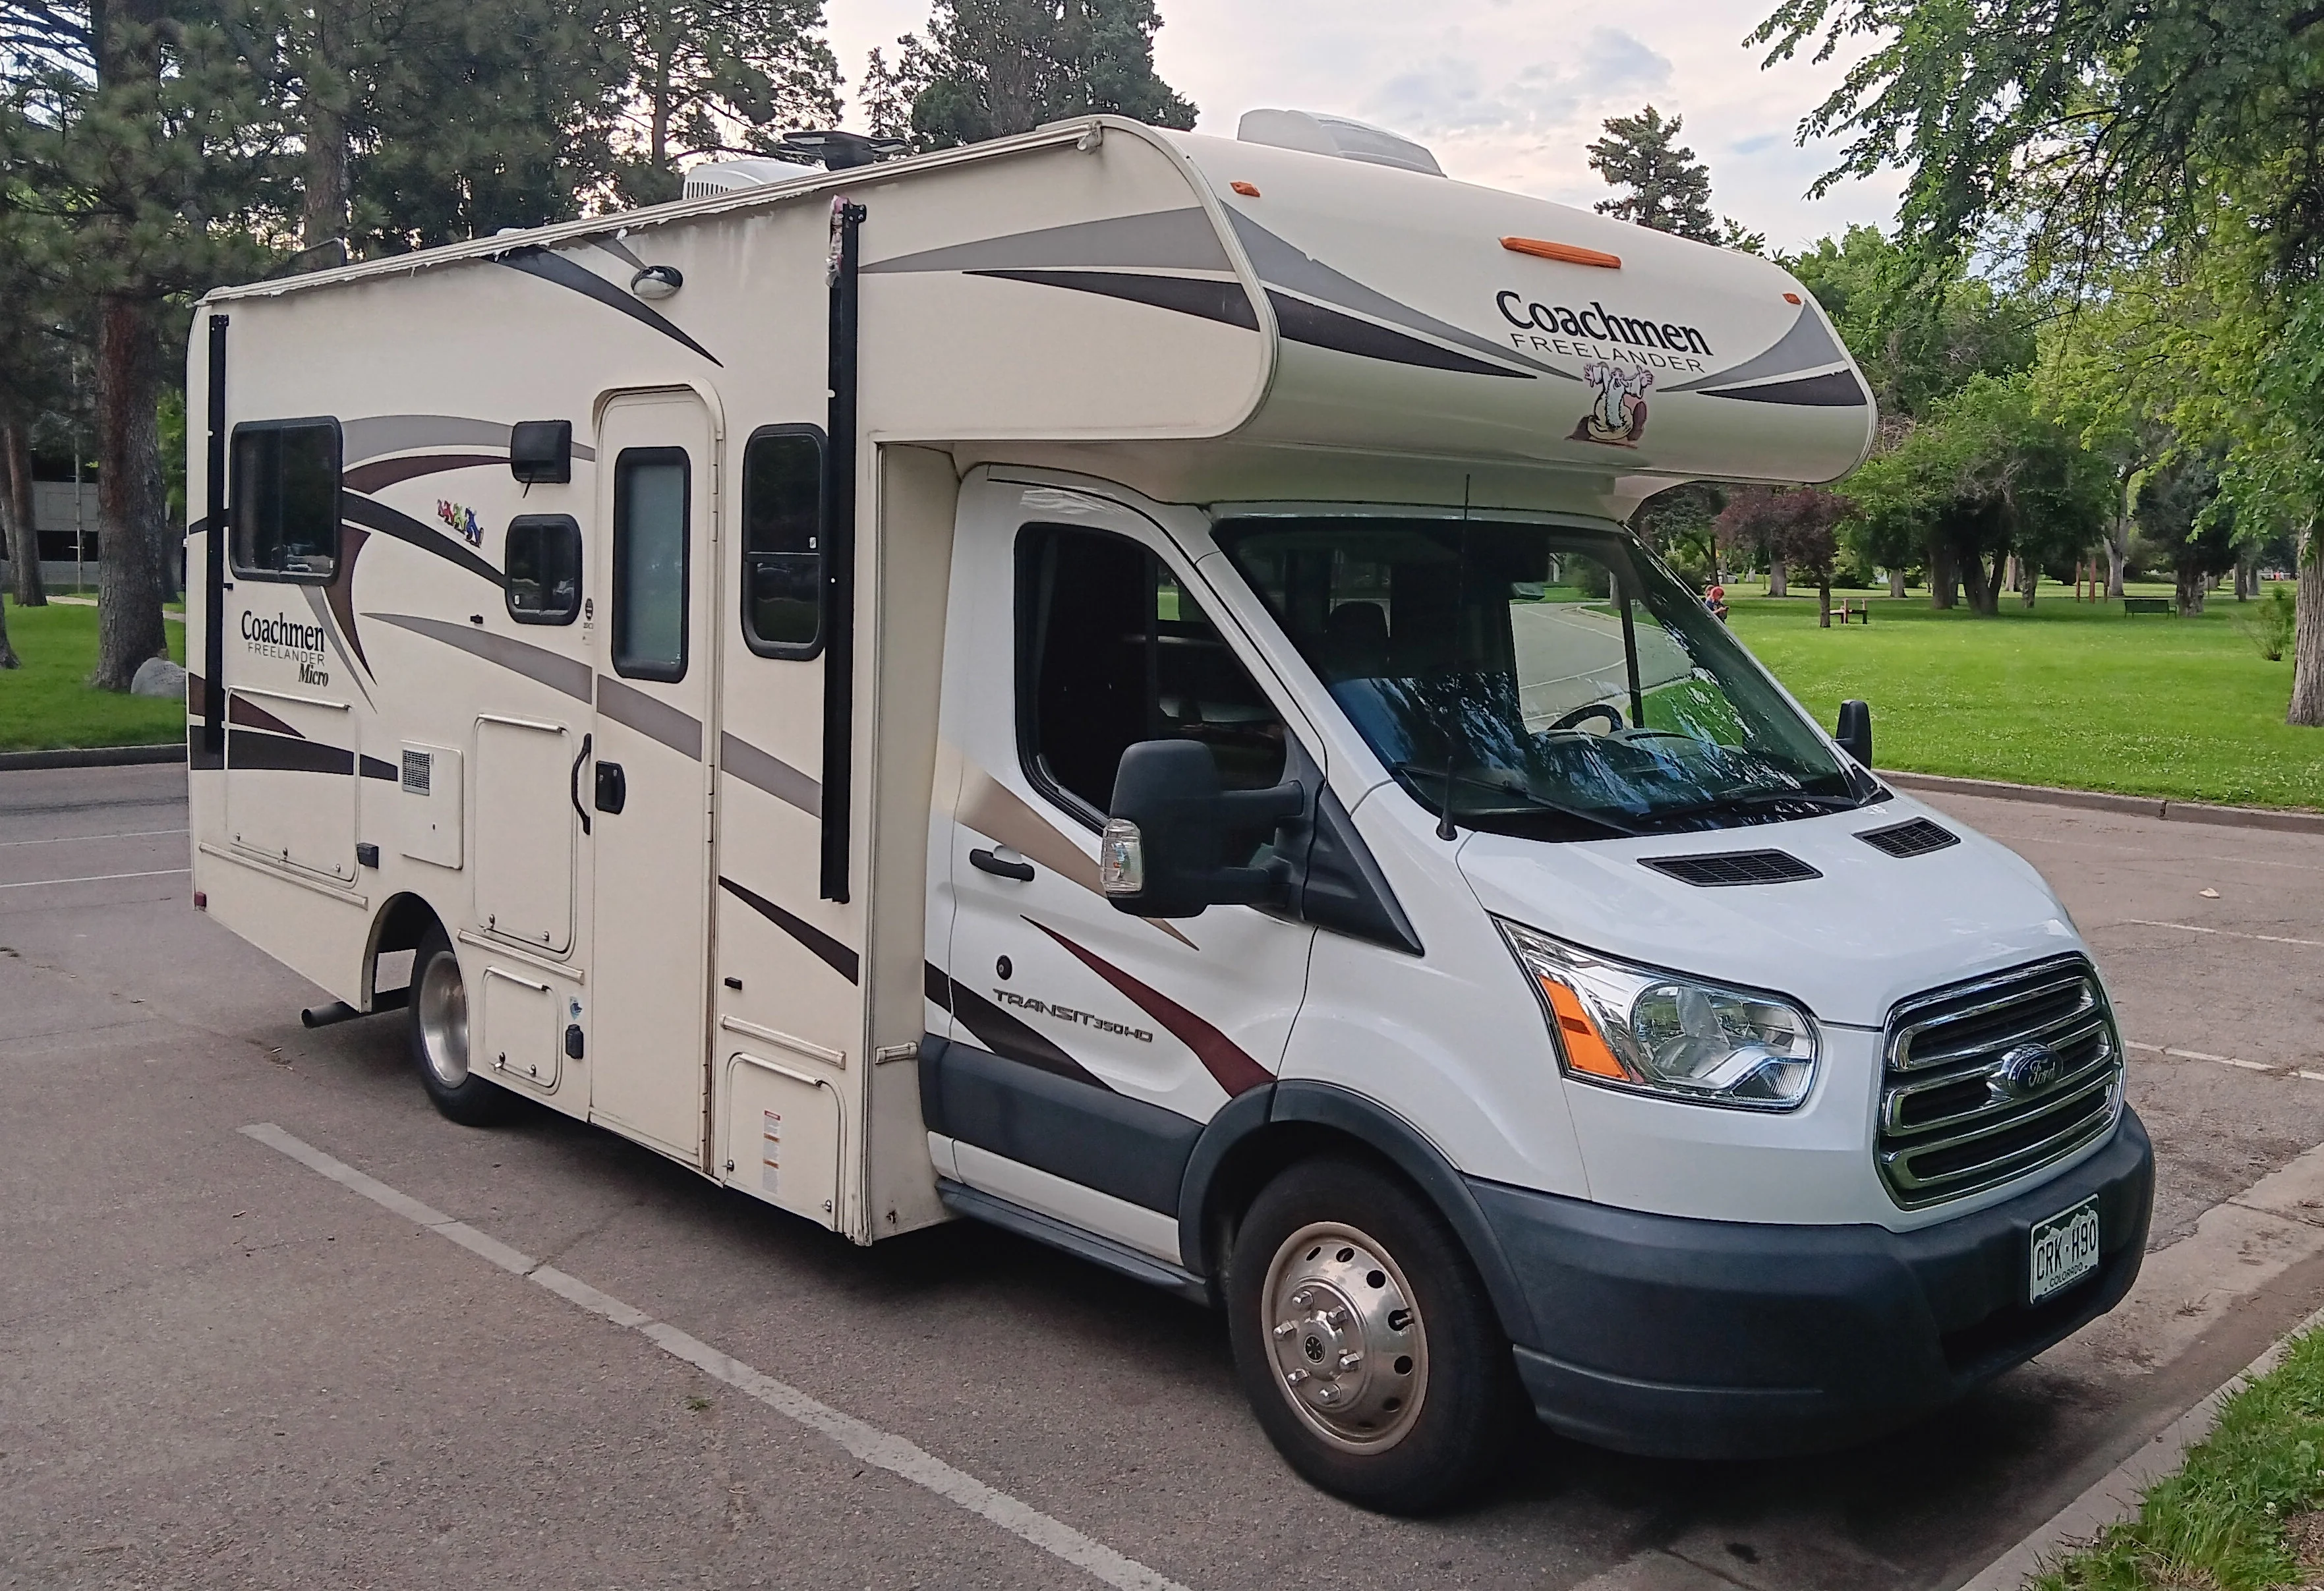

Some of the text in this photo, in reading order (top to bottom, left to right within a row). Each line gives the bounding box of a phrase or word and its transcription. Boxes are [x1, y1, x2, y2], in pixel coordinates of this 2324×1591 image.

[1496, 291, 1714, 356] Coachmen
[1510, 333, 1705, 373] FREELANDER
[241, 610, 325, 652] Coachmen
[248, 642, 326, 667] FREELANDER
[298, 663, 329, 687] Micro
[993, 988, 1094, 1026] TRANSIT
[2029, 1058, 2056, 1087] Ford
[2049, 1261, 2083, 1287] COLORADO
